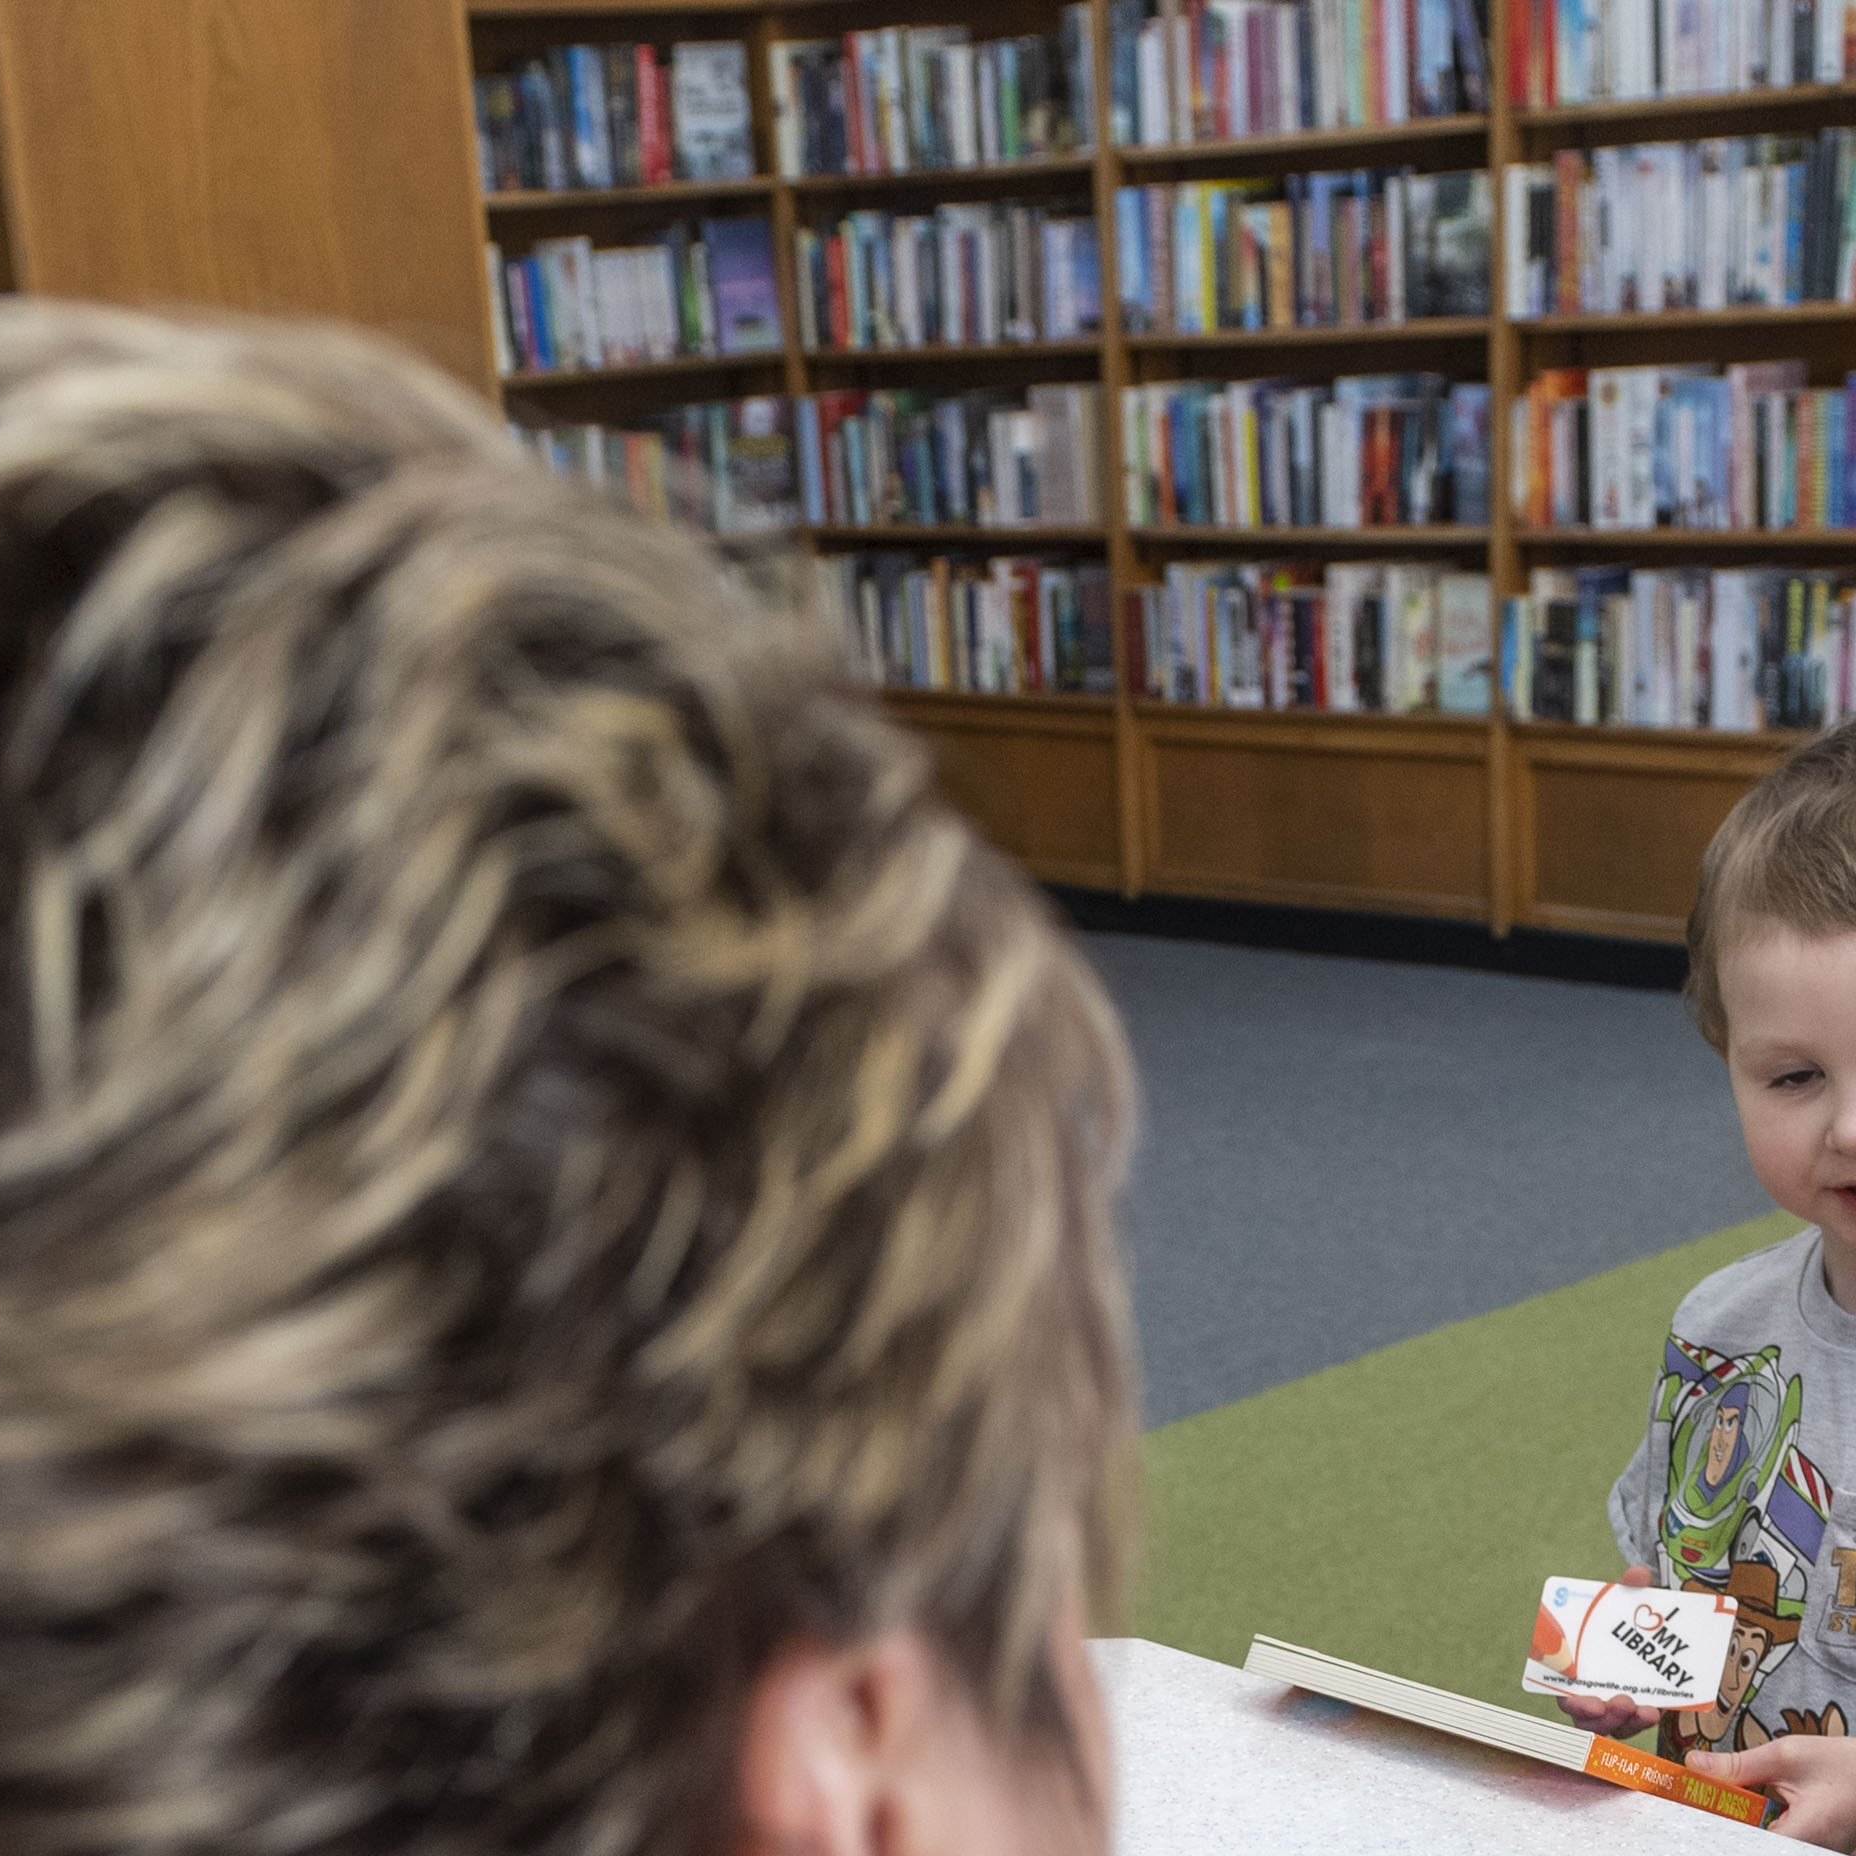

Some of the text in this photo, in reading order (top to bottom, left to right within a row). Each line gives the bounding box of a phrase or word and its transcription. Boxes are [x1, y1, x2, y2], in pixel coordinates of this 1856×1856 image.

[1663, 1606, 1680, 1622] I
[1611, 1620, 1694, 1689] LIBRARY
[1651, 1626, 1689, 1656] MY
[1543, 1675, 1694, 1699] www.glasgowlife.org.uk/libraries
[1600, 1752, 1675, 1790] FLIP-FLAP FRIENDS
[1684, 1777, 1751, 1819] FANCY DRESS
